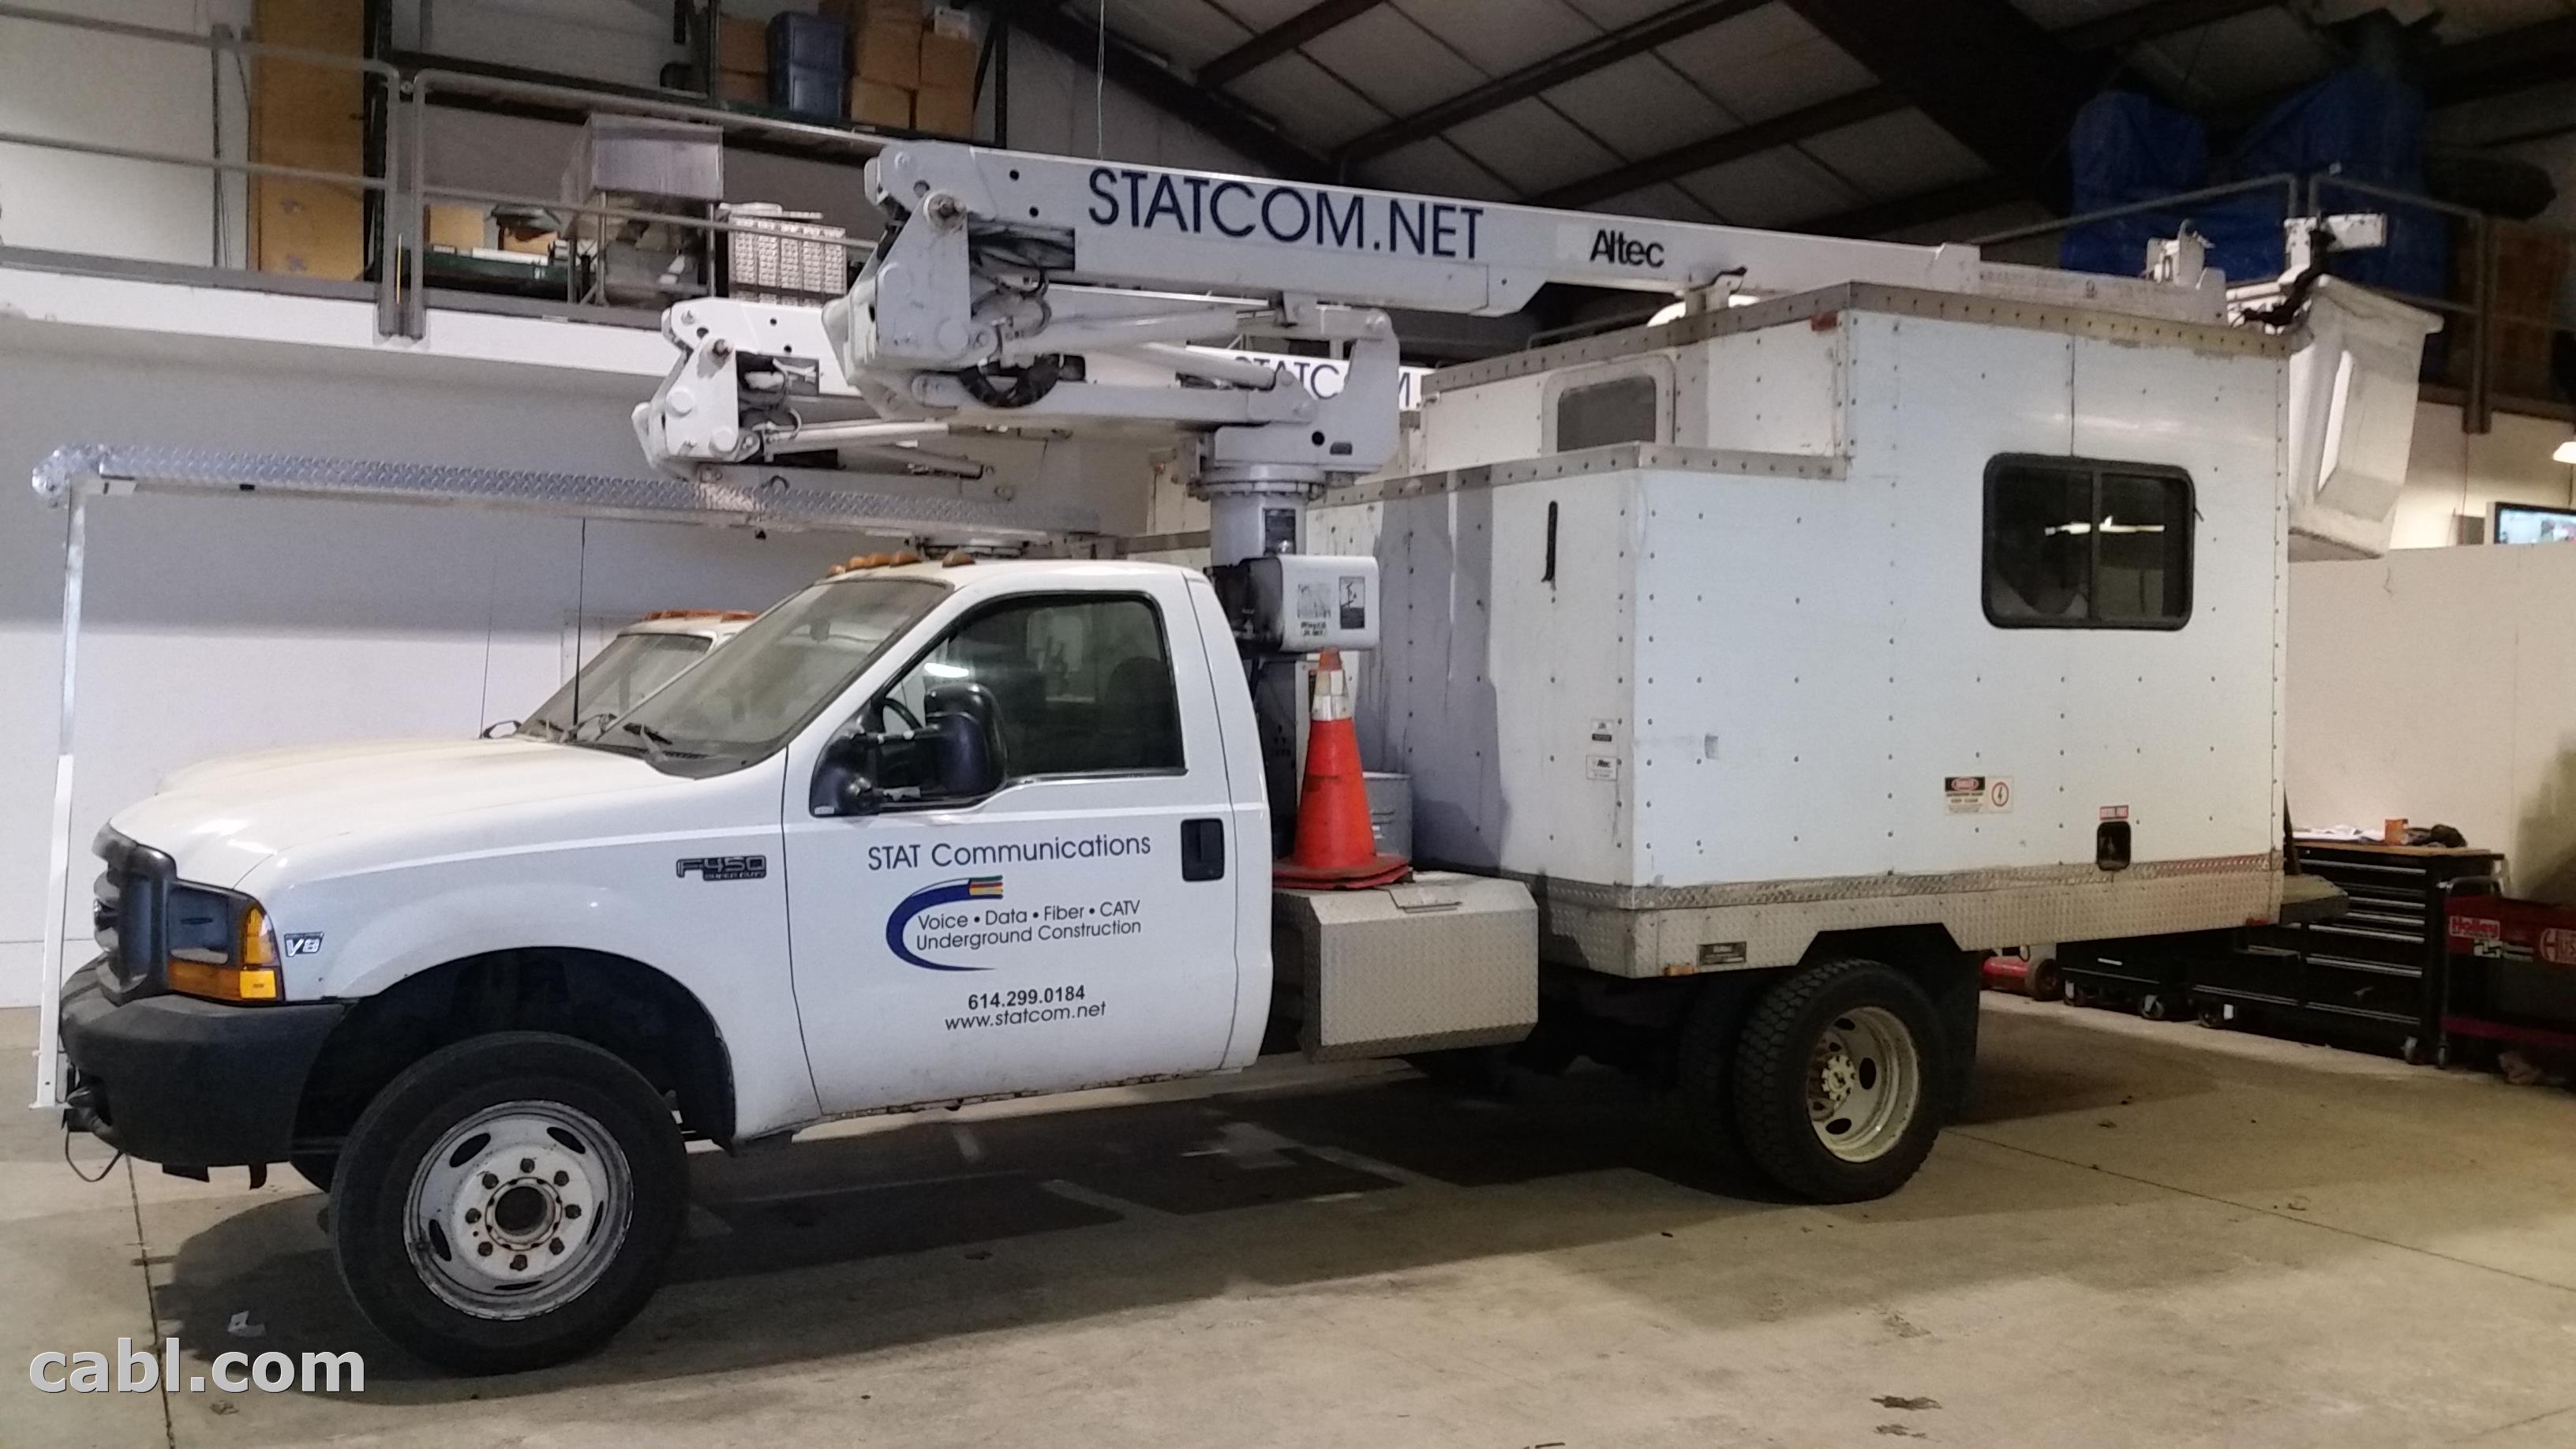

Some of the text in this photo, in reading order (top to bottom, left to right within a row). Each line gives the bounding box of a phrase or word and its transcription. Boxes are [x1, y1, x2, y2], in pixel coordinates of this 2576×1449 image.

[1088, 167, 1484, 260] STATCOM.NET
[1589, 229, 1665, 268] Altec
[868, 834, 1151, 871] STAT Communications
[918, 900, 1141, 930] Voice Data Fiber CATV
[286, 938, 320, 957] V8
[916, 920, 1142, 950] Underground Construction
[968, 985, 1085, 1009] 614.299.0184
[945, 1002, 1106, 1030] www.statcom.net
